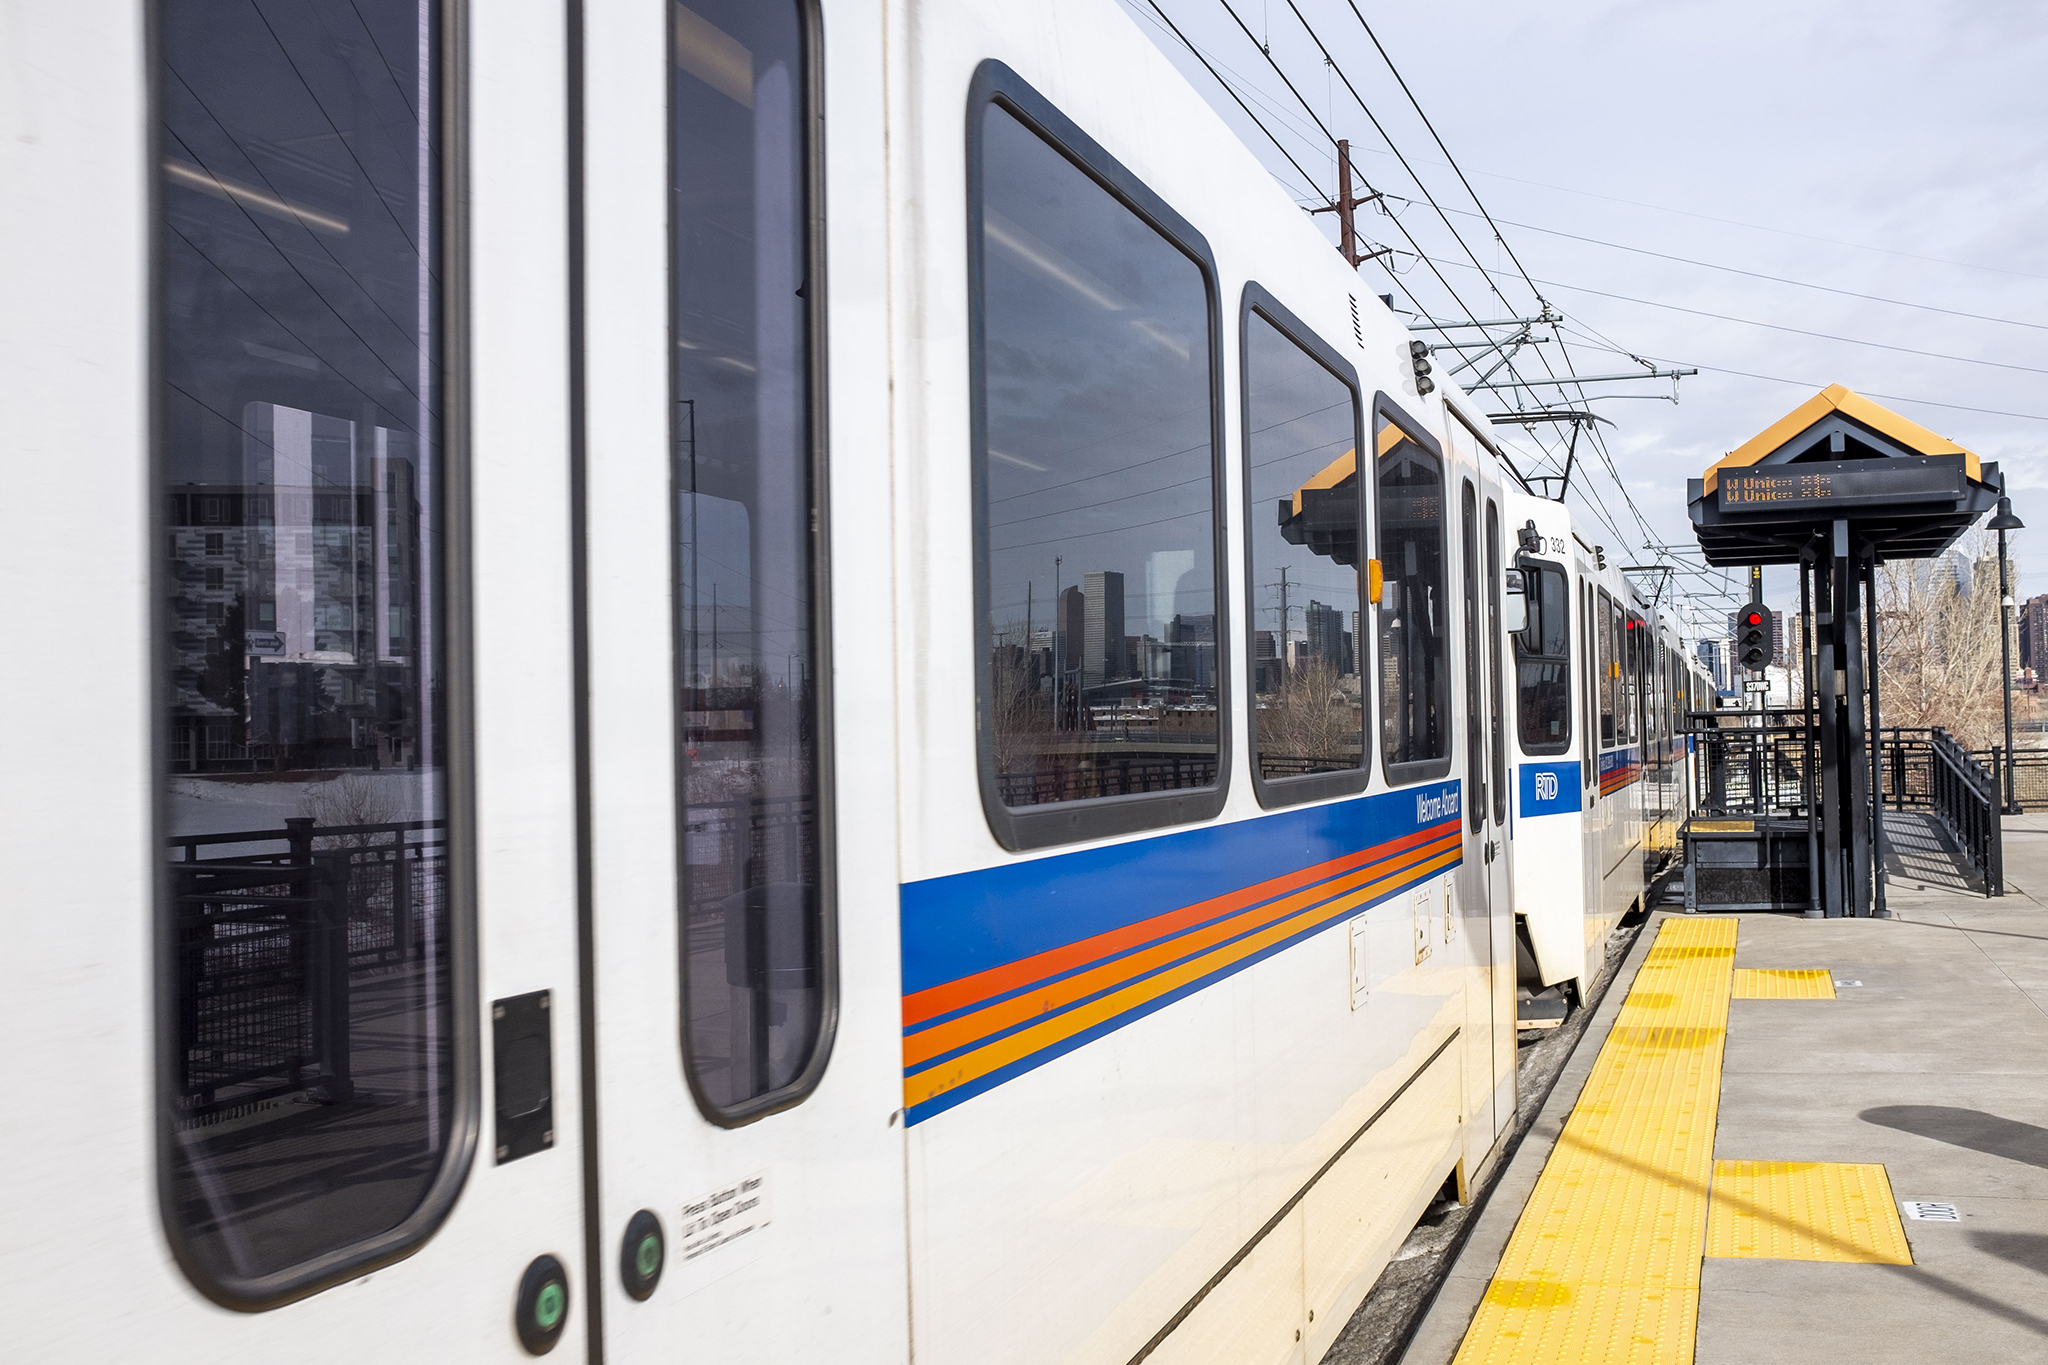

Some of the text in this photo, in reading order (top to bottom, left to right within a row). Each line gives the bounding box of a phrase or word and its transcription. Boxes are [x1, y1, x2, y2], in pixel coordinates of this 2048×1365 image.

[1726, 478, 1739, 490] W
[1726, 490, 1739, 502] W
[1550, 536, 1566, 554] 332
[1535, 772, 1559, 801] RTD
[1416, 785, 1459, 824] Welcome Aboard
